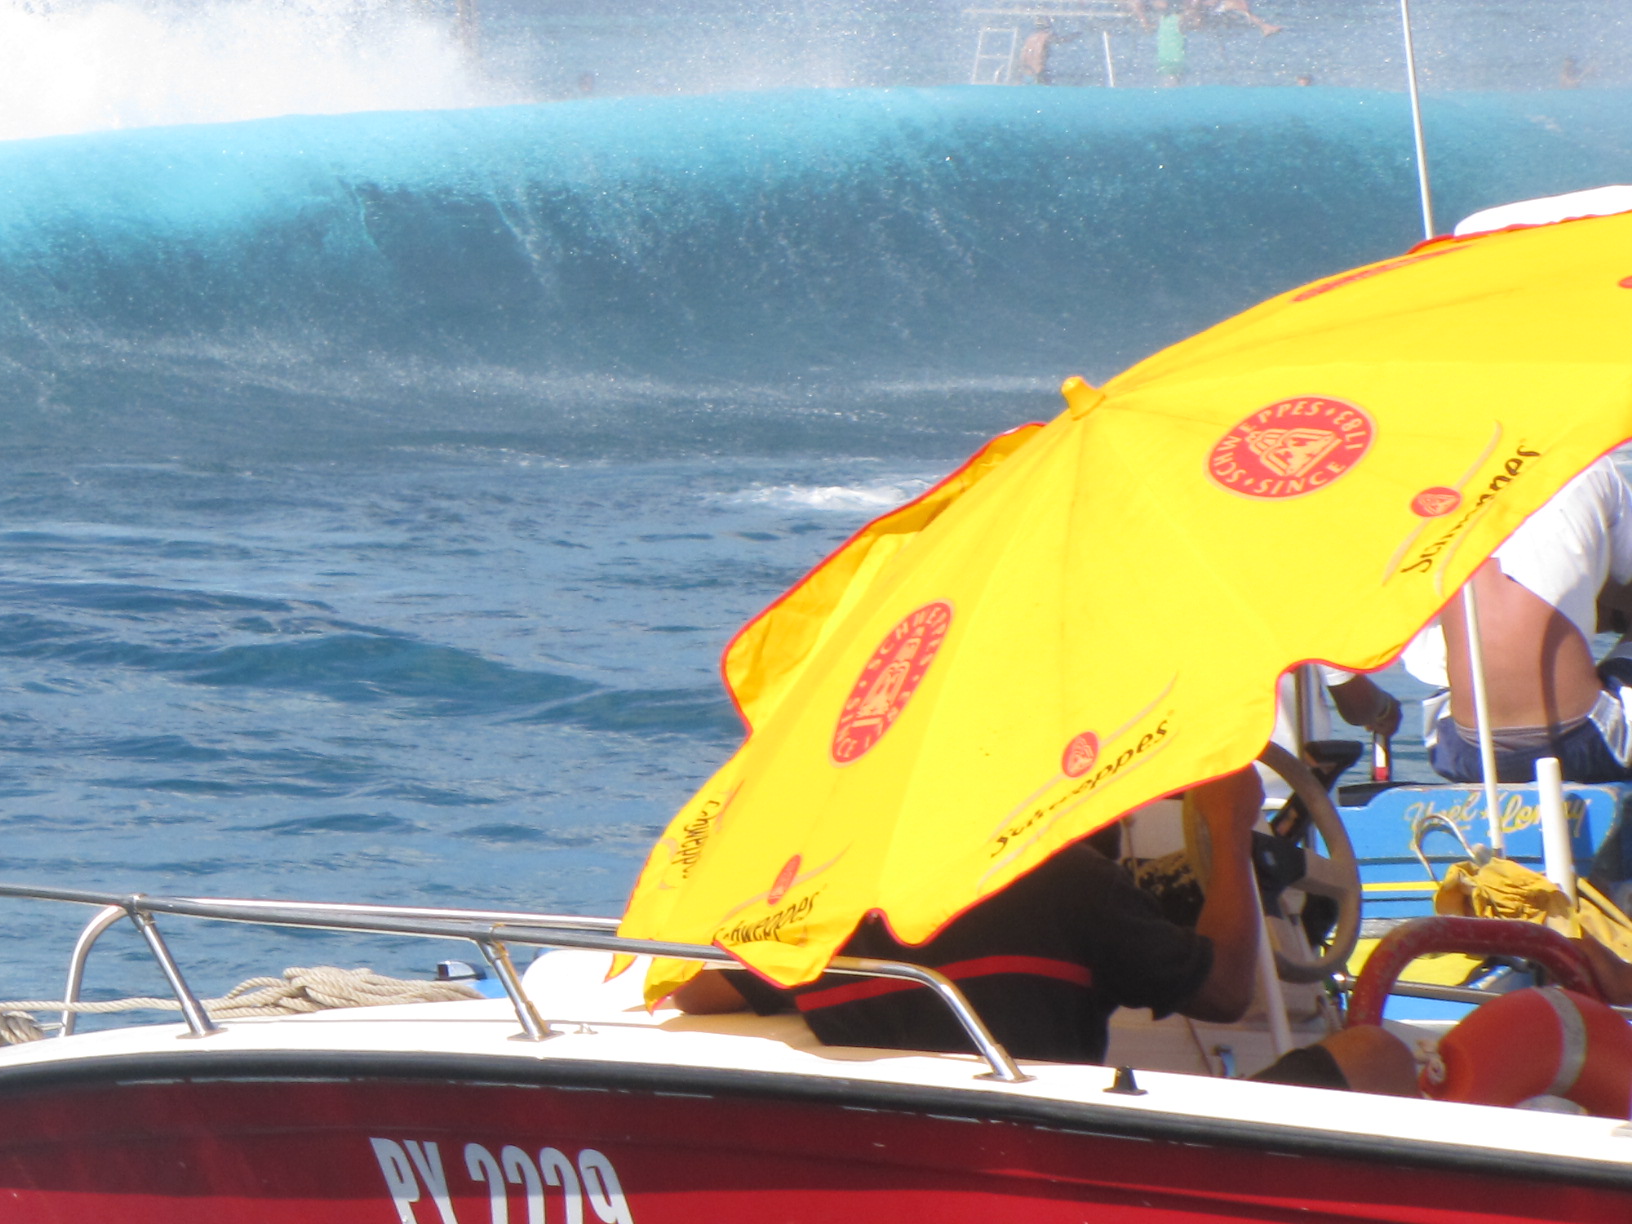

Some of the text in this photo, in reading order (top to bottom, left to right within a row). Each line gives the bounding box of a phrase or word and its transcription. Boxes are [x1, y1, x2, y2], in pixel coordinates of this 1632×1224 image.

[1213, 400, 1325, 484] SCHWEPPES
[1253, 460, 1347, 496] SINCE
[369, 1137, 459, 1224] PY
